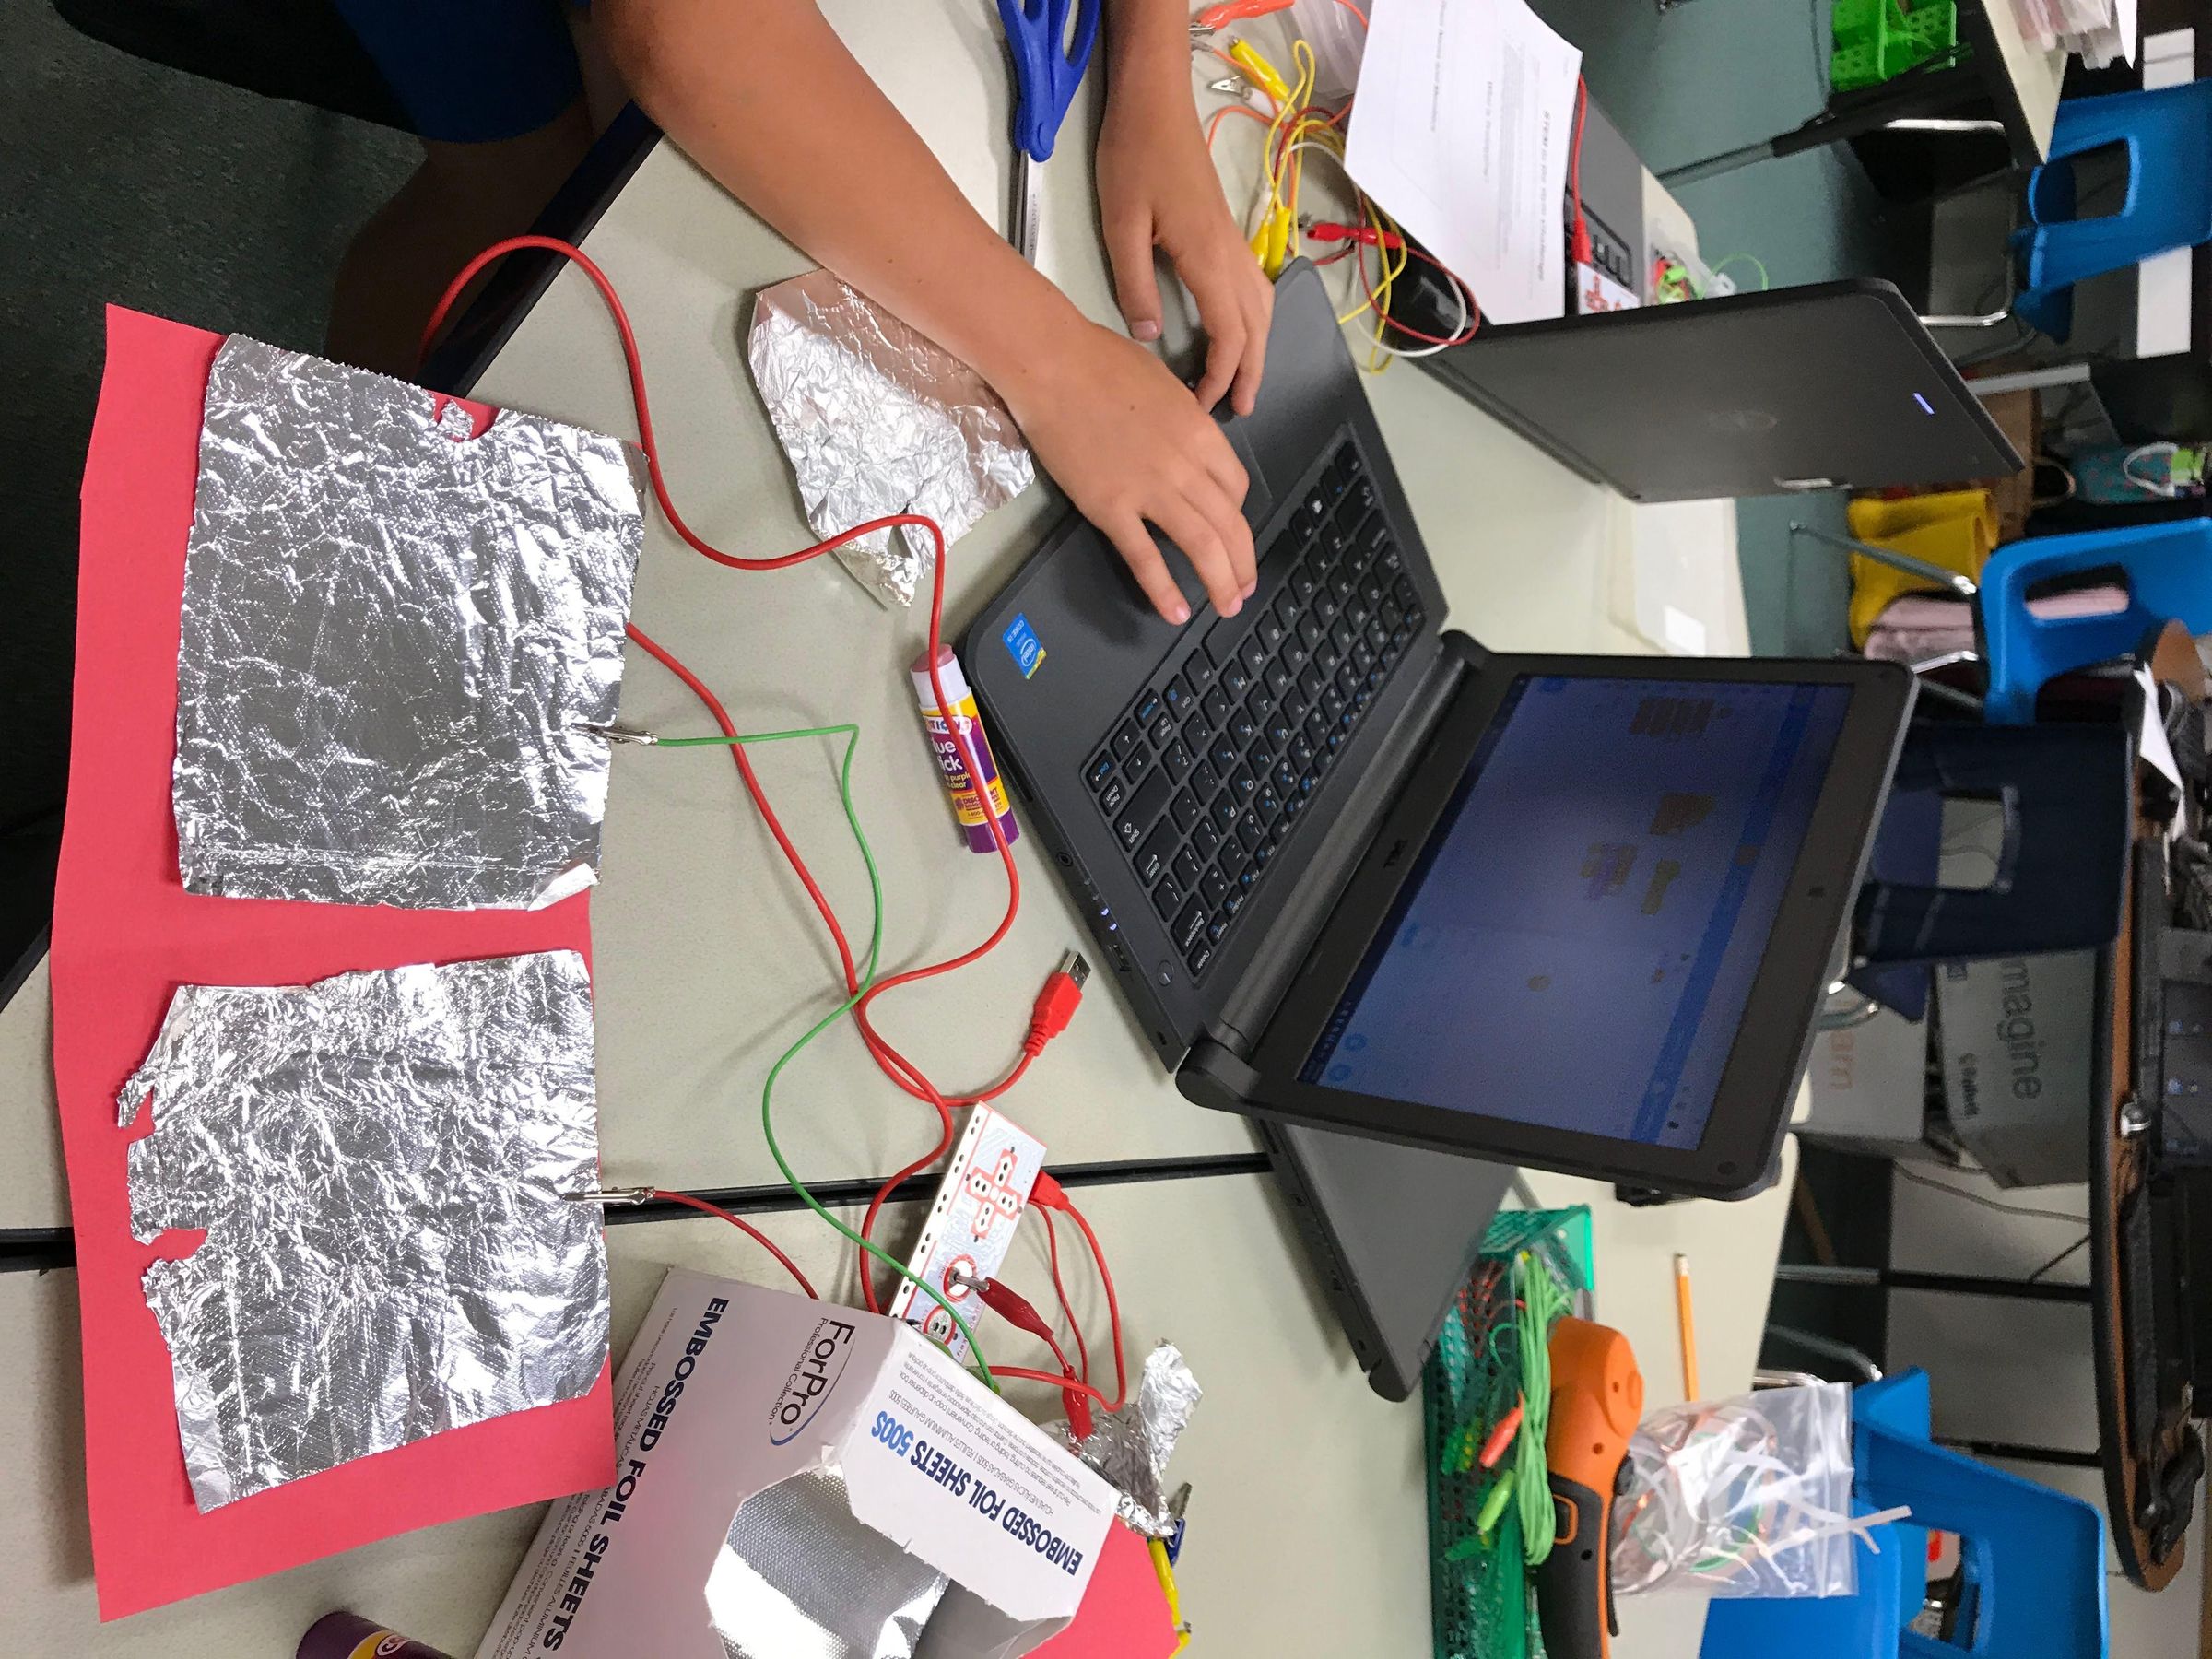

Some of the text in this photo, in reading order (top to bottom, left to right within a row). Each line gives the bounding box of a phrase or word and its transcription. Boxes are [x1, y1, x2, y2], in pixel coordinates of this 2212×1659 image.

[1021, 643, 1036, 664] intel
[1180, 695, 1192, 709] Ctrl
[1098, 760, 1111, 776] End
[1105, 784, 1122, 808] Page Down
[1127, 828, 1140, 845] Shift
[1382, 840, 1409, 868] DELL
[1147, 861, 1160, 880] Enter
[1183, 917, 1206, 947] Backspace
[1196, 949, 1211, 970] Delete
[1997, 961, 2046, 1100] magine
[768, 1317, 829, 1421] Professional Collection
[780, 1319, 855, 1426] ForPro
[626, 1391, 641, 1415] sheet
[641, 1384, 661, 1418] HOJAS
[869, 1409, 917, 1457] 500S
[924, 1416, 957, 1444] ALUMINIUM
[946, 1406, 976, 1433] Convenient
[953, 1437, 976, 1458] FEUILLES
[542, 1297, 729, 1651] EMBOSSED FOIL SHEETS
[909, 1438, 973, 1498] SHEETS
[987, 1462, 1016, 1488] GRABADAS
[572, 1492, 591, 1524] folding
[588, 1484, 612, 1524] ABADAS
[969, 1479, 1006, 1521] FOIL
[1002, 1503, 1084, 1576] EMBOSSED
[554, 1555, 578, 1595] FEUILLES
[524, 1569, 555, 1623] Convenient
[524, 1596, 558, 1654] ALUMINIUM
